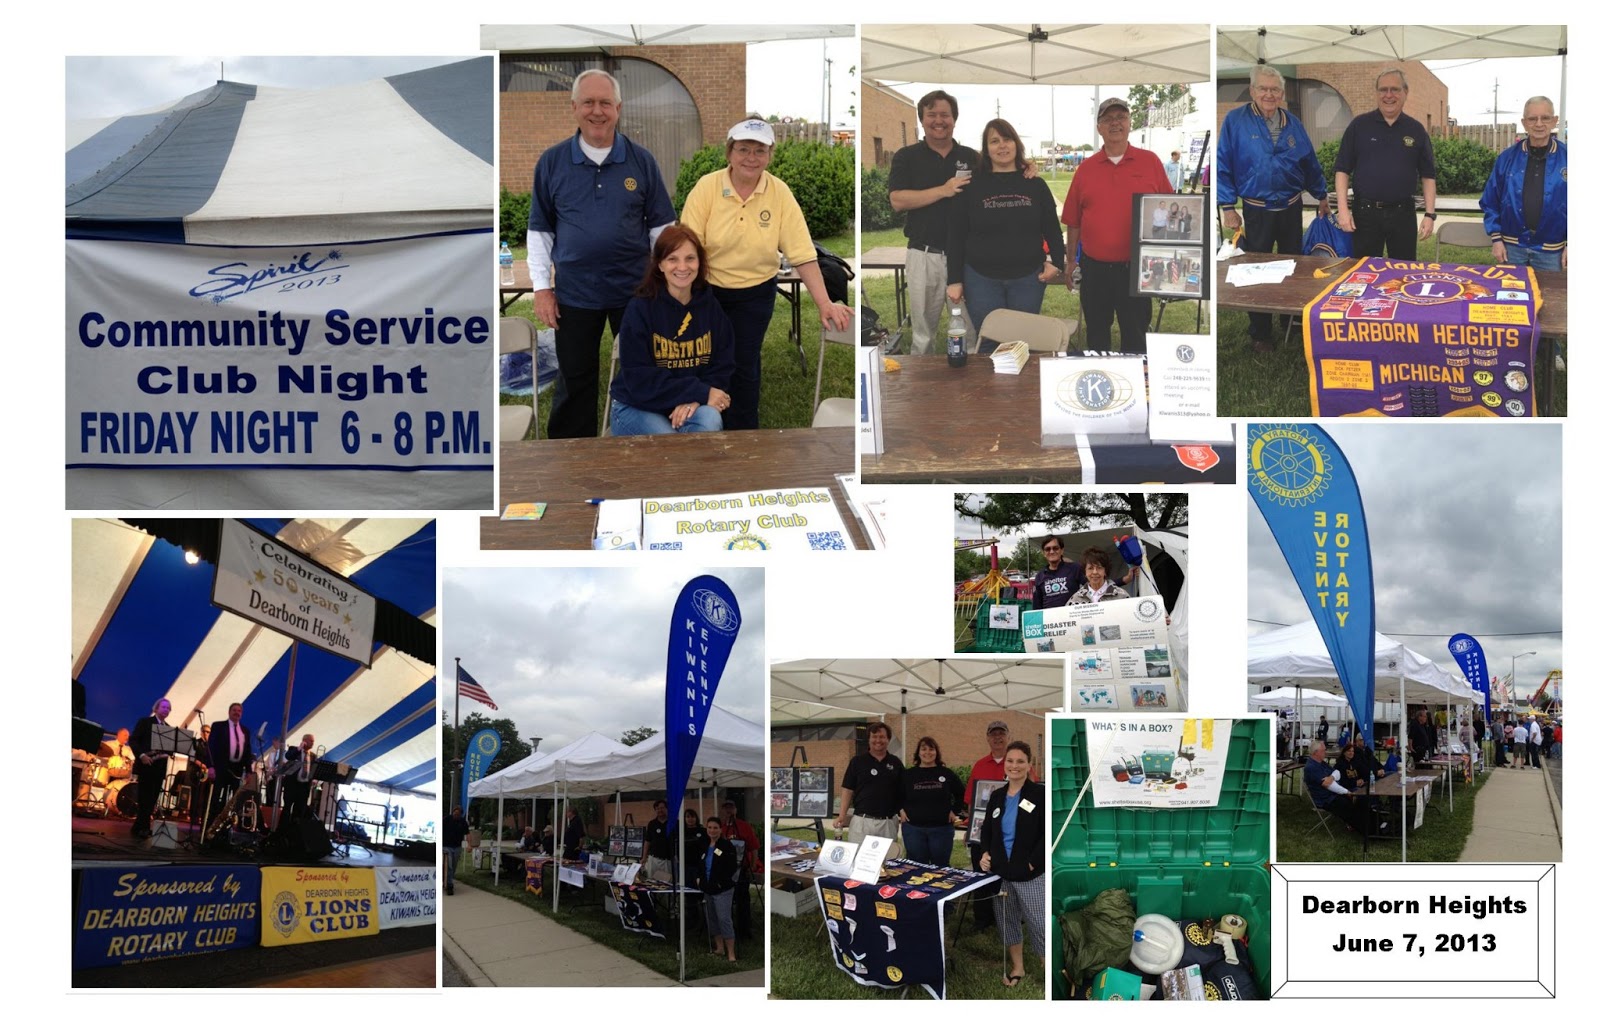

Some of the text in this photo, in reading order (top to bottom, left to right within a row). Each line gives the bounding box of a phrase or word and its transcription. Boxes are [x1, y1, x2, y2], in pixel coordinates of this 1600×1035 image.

[189, 251, 327, 297] Spirit
[1368, 261, 1442, 272] LIONS
[278, 274, 342, 293] 2013
[1411, 274, 1466, 283] LIONS
[1415, 282, 1445, 298] L
[79, 308, 489, 355] Community Service
[1323, 322, 1519, 347] DEARBORN HEIGHTS
[1181, 348, 1191, 359] K
[137, 364, 428, 400] Club Night
[1082, 373, 1107, 382] KIWANIS
[1380, 364, 1465, 385] MICHIGAN
[1079, 386, 1111, 408] INTERNATIONAL
[1087, 379, 1104, 402] K
[81, 411, 199, 455] FRIDAY
[211, 410, 318, 455] NIGHT
[341, 410, 360, 455] 6
[394, 410, 413, 456] 8
[425, 411, 491, 455] P.M.
[645, 491, 831, 515] Dearborn Heights
[676, 512, 808, 534] Rotary Club
[261, 542, 348, 602] Celebrating
[273, 568, 340, 615] 50 years
[1045, 582, 1068, 594] BOX
[249, 589, 351, 650] Dearborn Heights
[299, 604, 310, 615] of
[711, 600, 721, 620] K
[1025, 629, 1042, 637] BOX
[1043, 621, 1077, 629] DISASTER
[686, 619, 697, 736] KIWANIS
[700, 628, 708, 706] EVENT
[1129, 723, 1138, 731] IN
[1149, 724, 1173, 732] BOX?
[113, 873, 242, 901] Sponsored by
[296, 869, 350, 886] Sponsored by
[306, 888, 369, 898] DEARBORN HEIGHTS
[83, 902, 256, 930] DEARBORN HEIGHTS
[282, 903, 291, 925] L
[304, 898, 372, 917] LIONS
[390, 907, 421, 921] KIWANIS
[310, 914, 369, 933] CLUB
[107, 927, 238, 957] ROTARY CLUB
[1225, 978, 1238, 1000] ango
